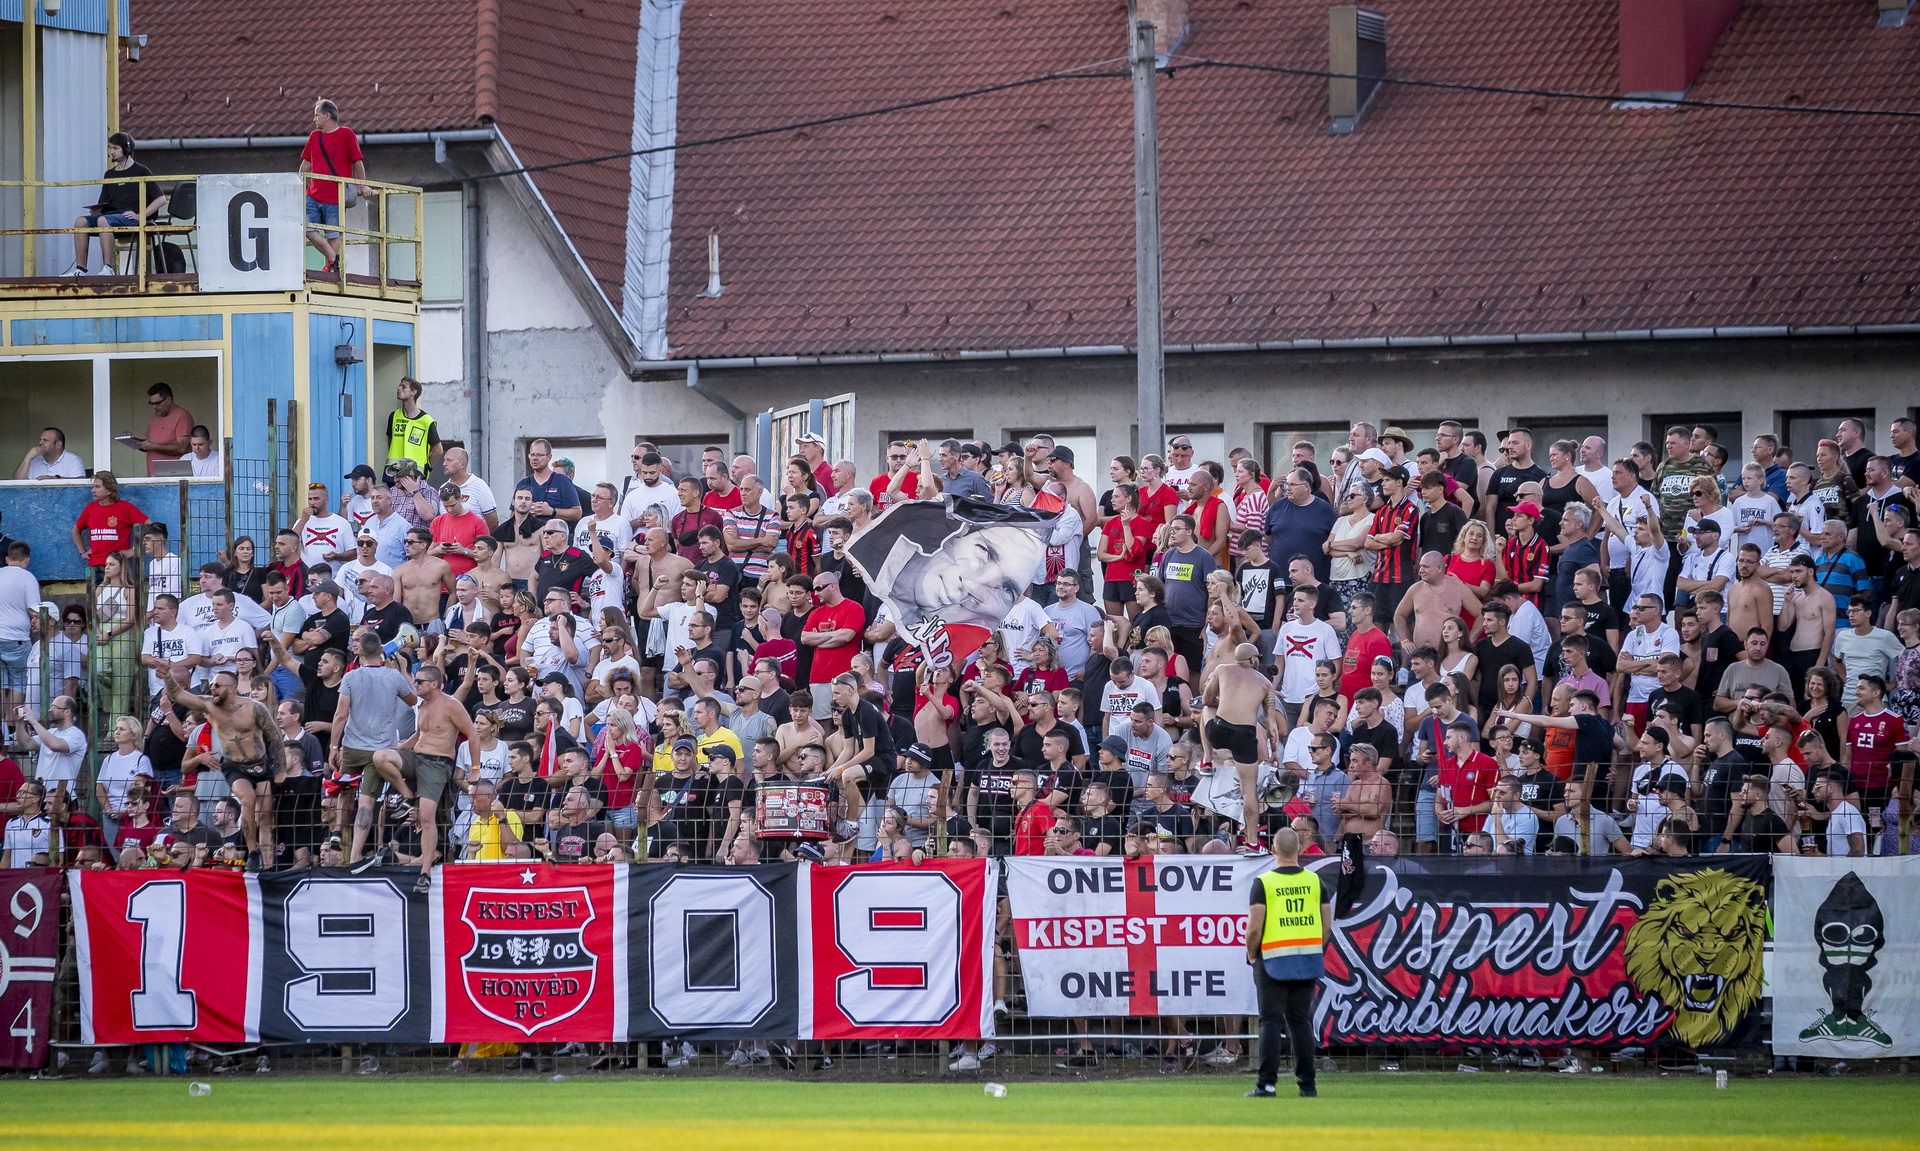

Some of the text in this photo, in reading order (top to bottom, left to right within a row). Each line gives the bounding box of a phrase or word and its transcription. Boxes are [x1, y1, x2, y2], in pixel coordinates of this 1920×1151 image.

[227, 190, 271, 272] G
[1168, 565, 1191, 574] TOMMY
[1243, 574, 1267, 595] NIKE SB
[1735, 738, 1762, 746] KISPES
[1857, 733, 1875, 748] 23
[1047, 865, 1234, 895] ONE LOVE
[1275, 886, 1312, 897] SECURITY
[10, 882, 44, 939] 9
[478, 901, 579, 920] KISPEST
[1285, 898, 1305, 913] 017
[1028, 915, 1249, 948] KISPEST 1909
[1304, 857, 1644, 1000] Kispest
[127, 871, 962, 1031] 1 9 0 9
[480, 942, 578, 960] 19 09
[480, 973, 580, 997] HONVÉD
[1060, 970, 1227, 999] ONE LIFE
[514, 1000, 547, 1019] FC
[1313, 973, 1669, 1042] Troublemakers
[10, 998, 36, 1054] 4
